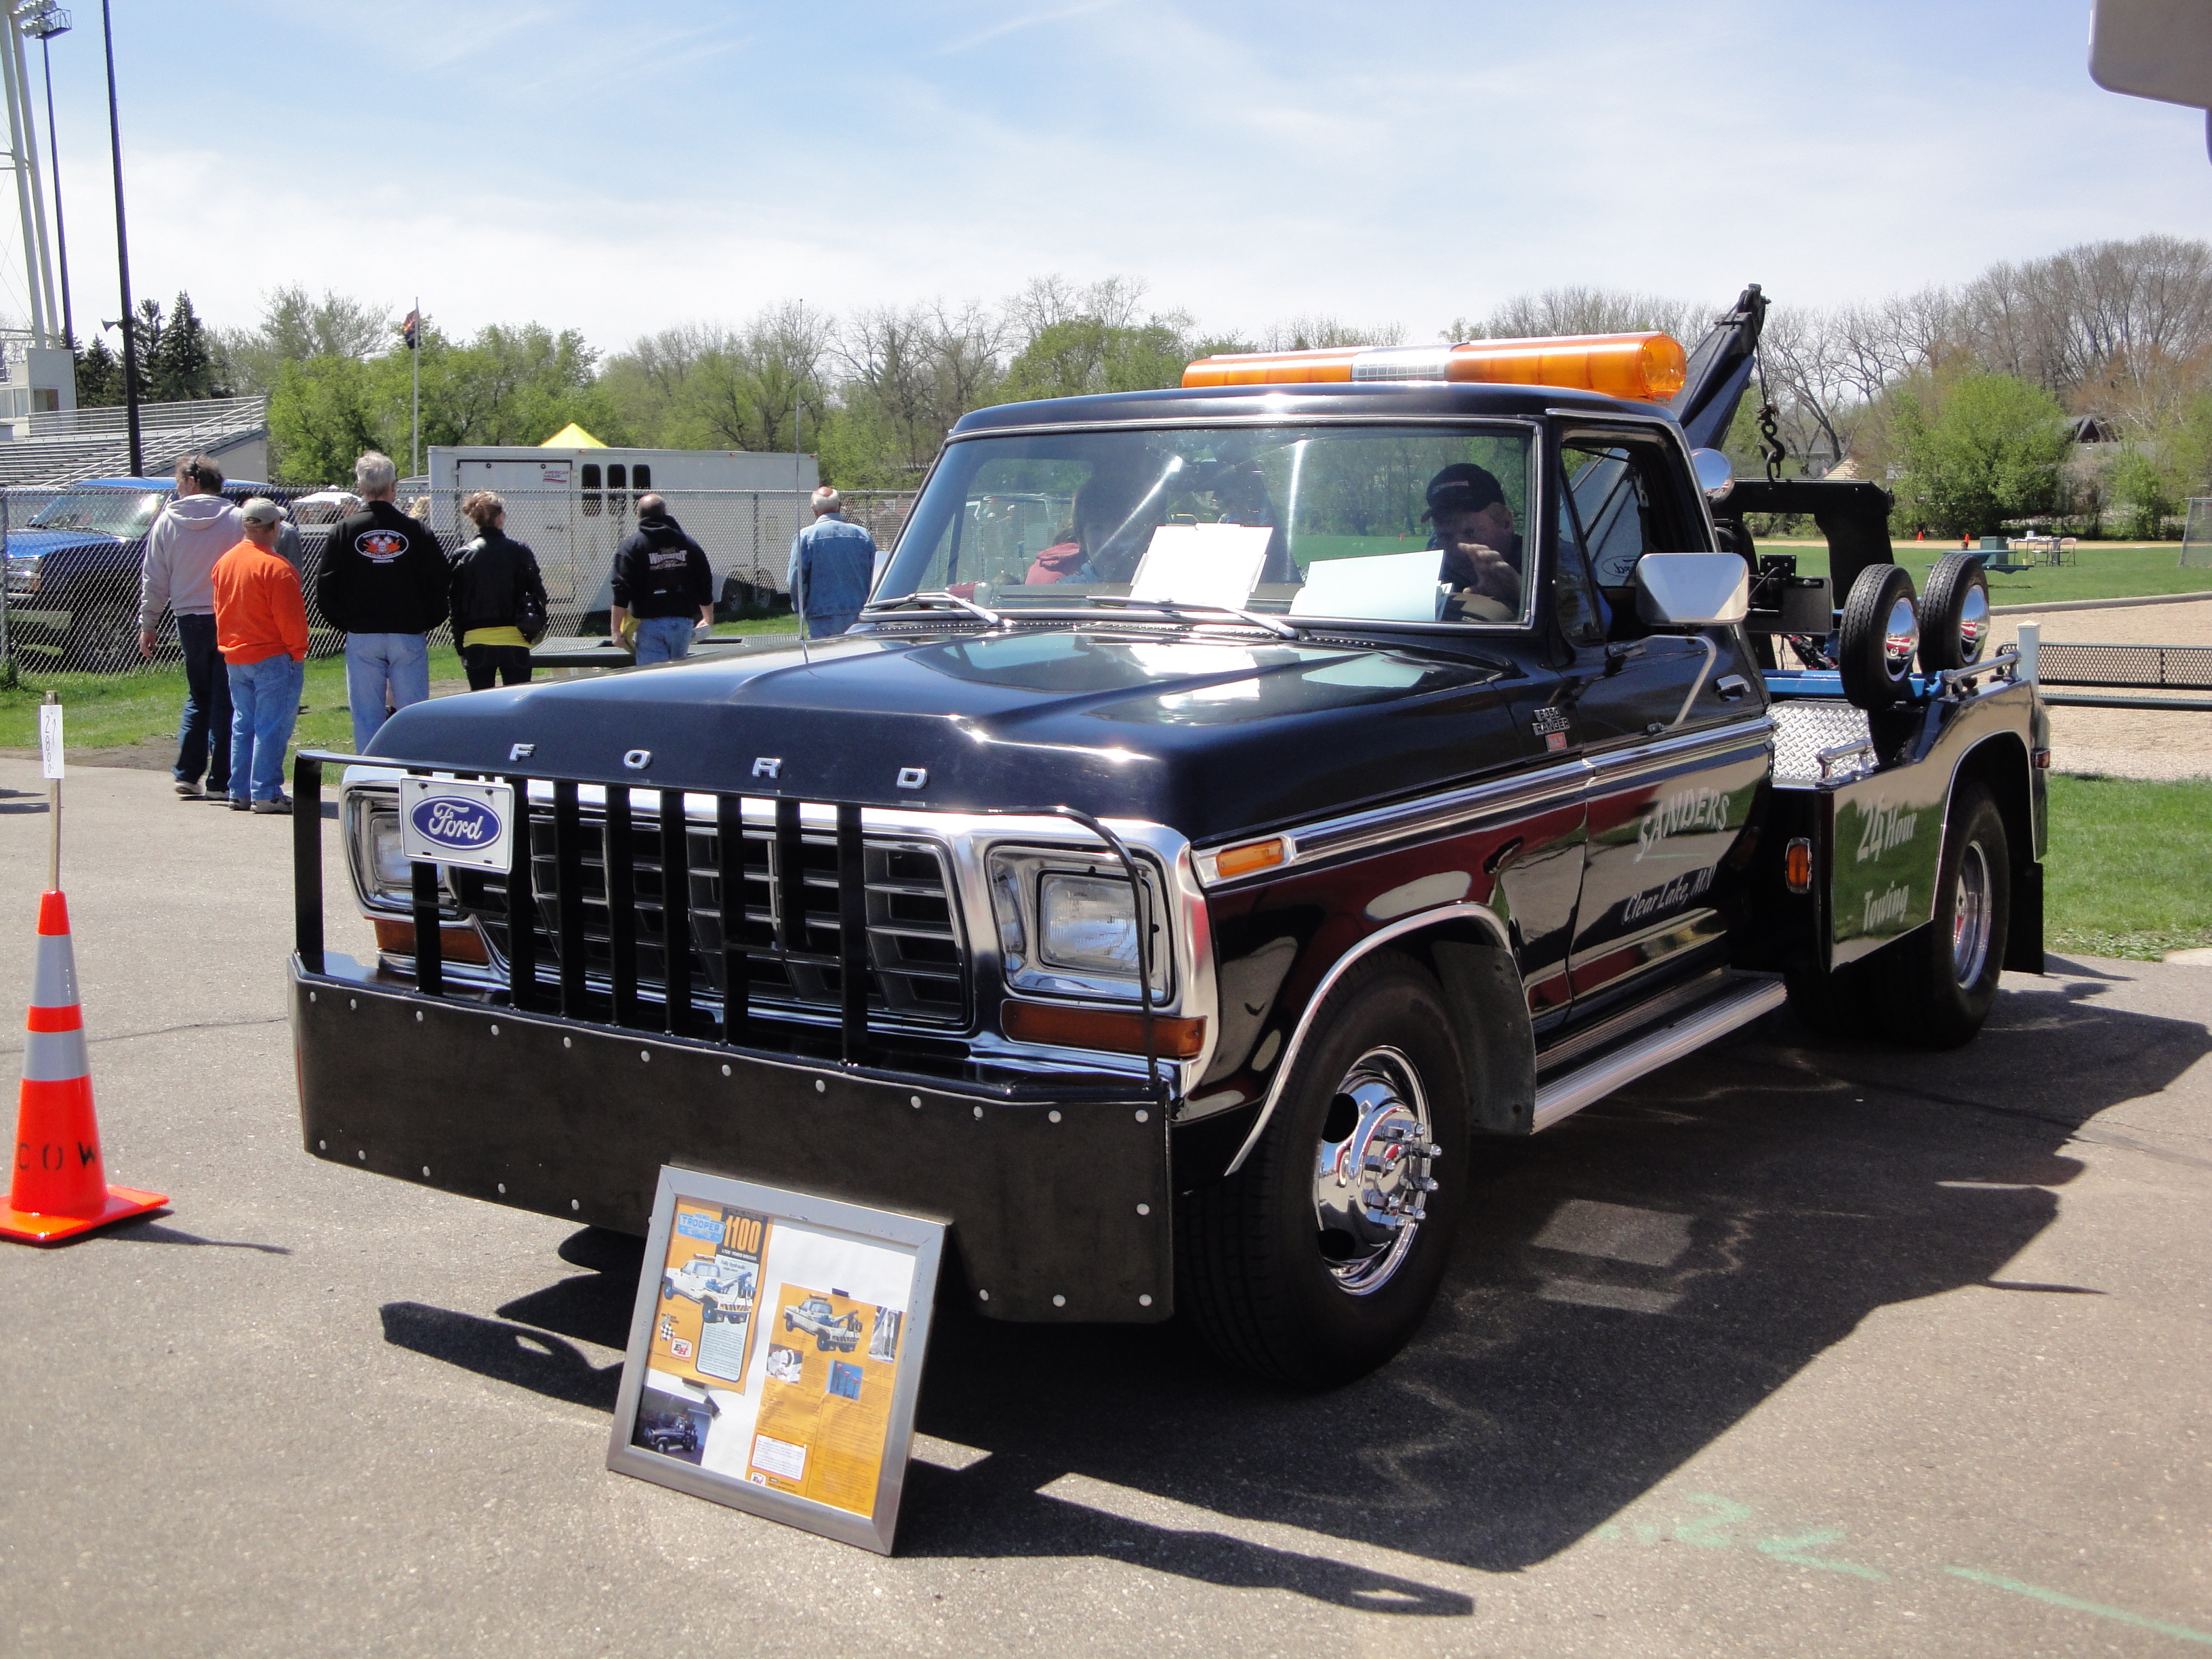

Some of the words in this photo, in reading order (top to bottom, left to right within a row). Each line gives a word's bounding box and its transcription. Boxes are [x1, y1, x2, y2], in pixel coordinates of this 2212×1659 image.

[1536, 718, 1570, 734] RANGER
[1539, 708, 1561, 720] F350
[428, 802, 484, 840] Ford
[1634, 786, 1730, 863] SANDERS
[1856, 792, 1885, 863] 24
[1884, 808, 1918, 851] Hour
[1622, 890, 1660, 924] Clear
[1864, 880, 1909, 931] Towing
[682, 1216, 720, 1231] TROOPER
[724, 1215, 762, 1254] 1100
